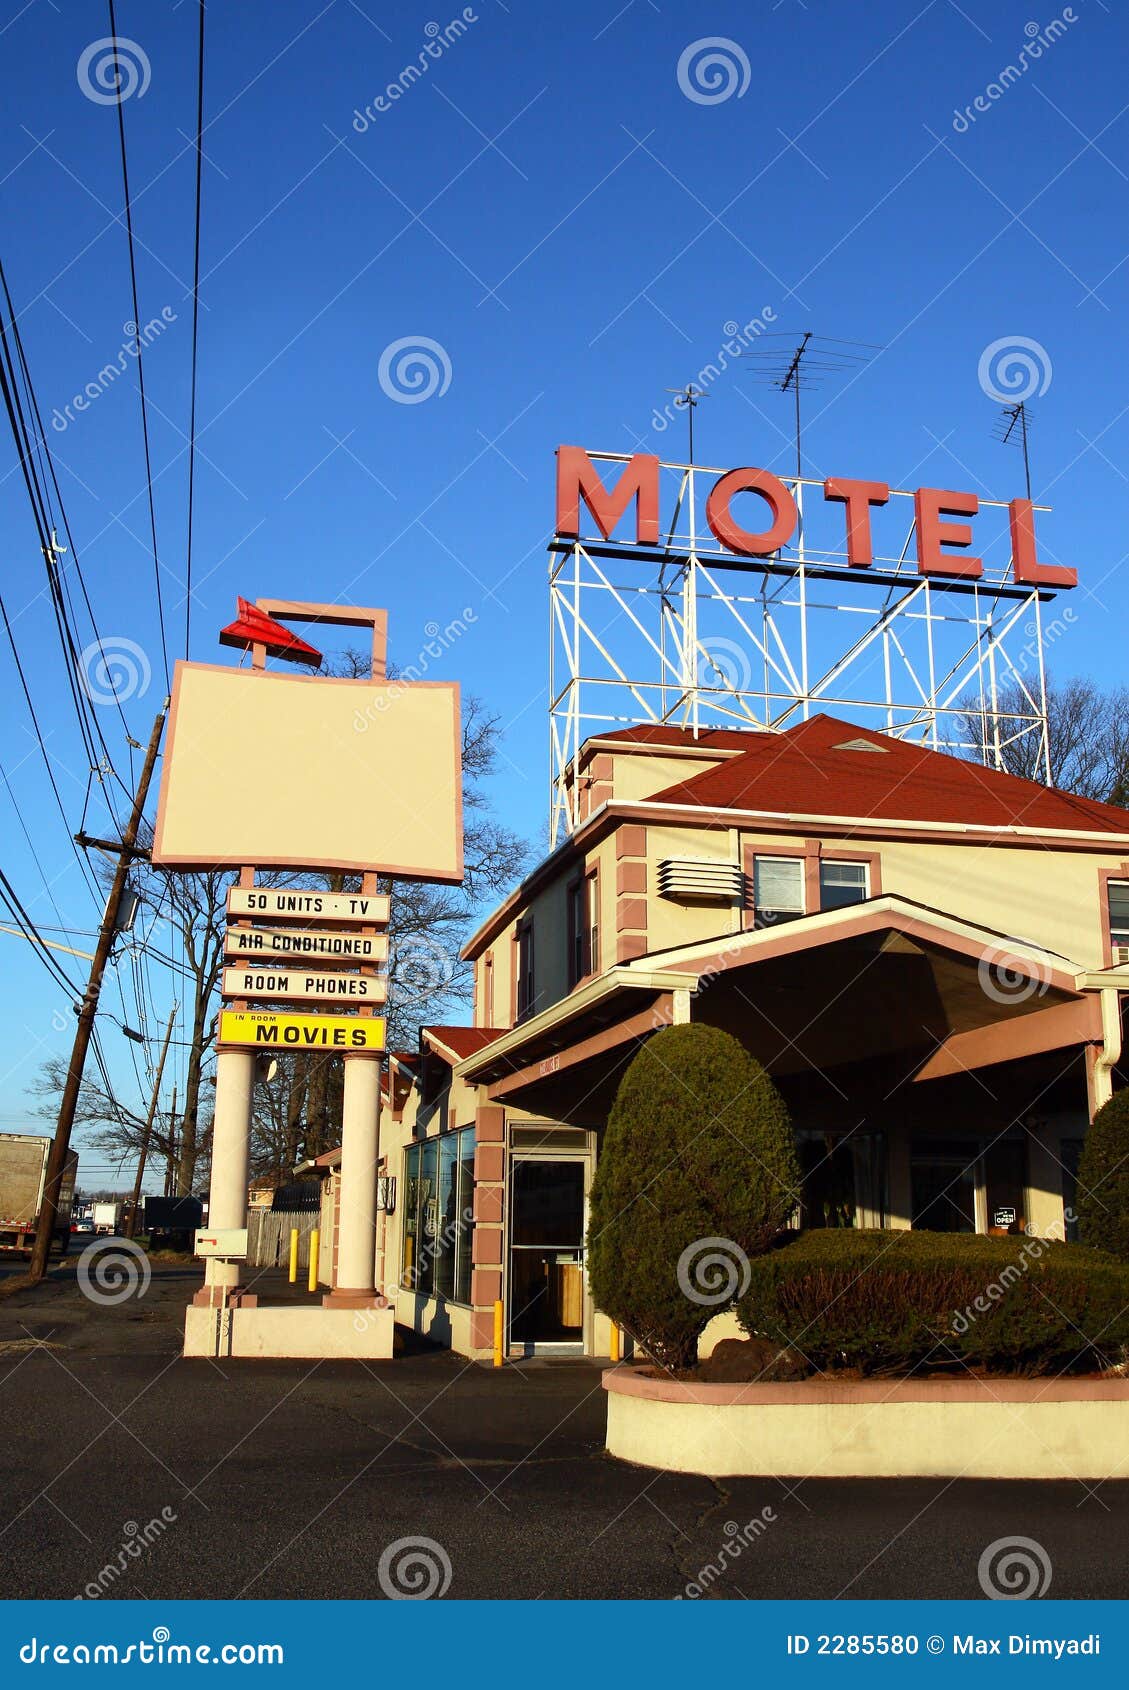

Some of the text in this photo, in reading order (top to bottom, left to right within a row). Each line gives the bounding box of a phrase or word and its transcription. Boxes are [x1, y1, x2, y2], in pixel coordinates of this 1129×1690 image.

[556, 445, 1077, 588] MOTEL
[247, 894, 267, 909] 50
[276, 895, 323, 912] UNITS
[349, 900, 369, 914] TV
[239, 934, 372, 954] AIR CONDITIONED
[244, 975, 368, 994] ROOM PHONES
[256, 1025, 367, 1046] MOVIES
